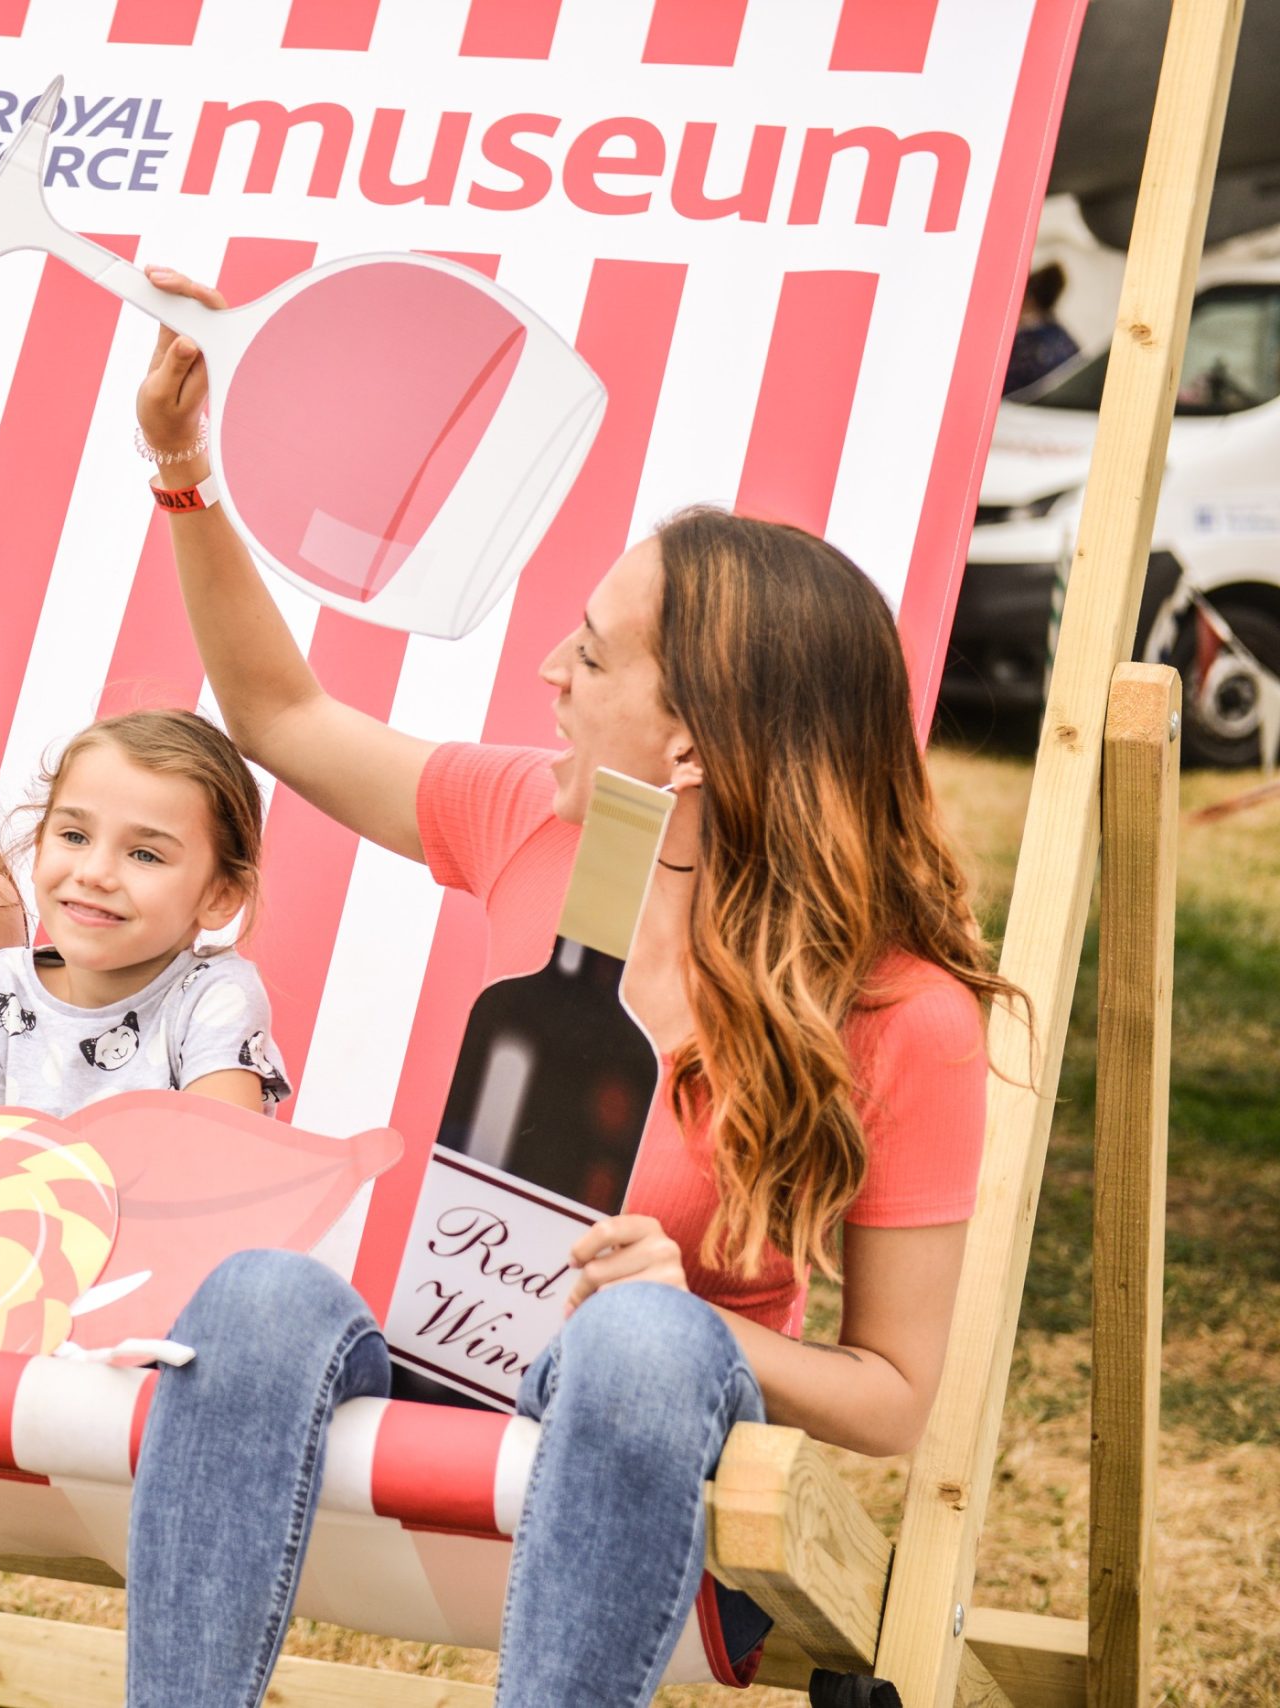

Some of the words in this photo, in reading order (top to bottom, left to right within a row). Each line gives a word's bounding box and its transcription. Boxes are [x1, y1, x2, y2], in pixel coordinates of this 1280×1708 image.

[179, 99, 973, 234] museum
[427, 1205, 570, 1300] Red
[415, 1279, 531, 1379] Win
